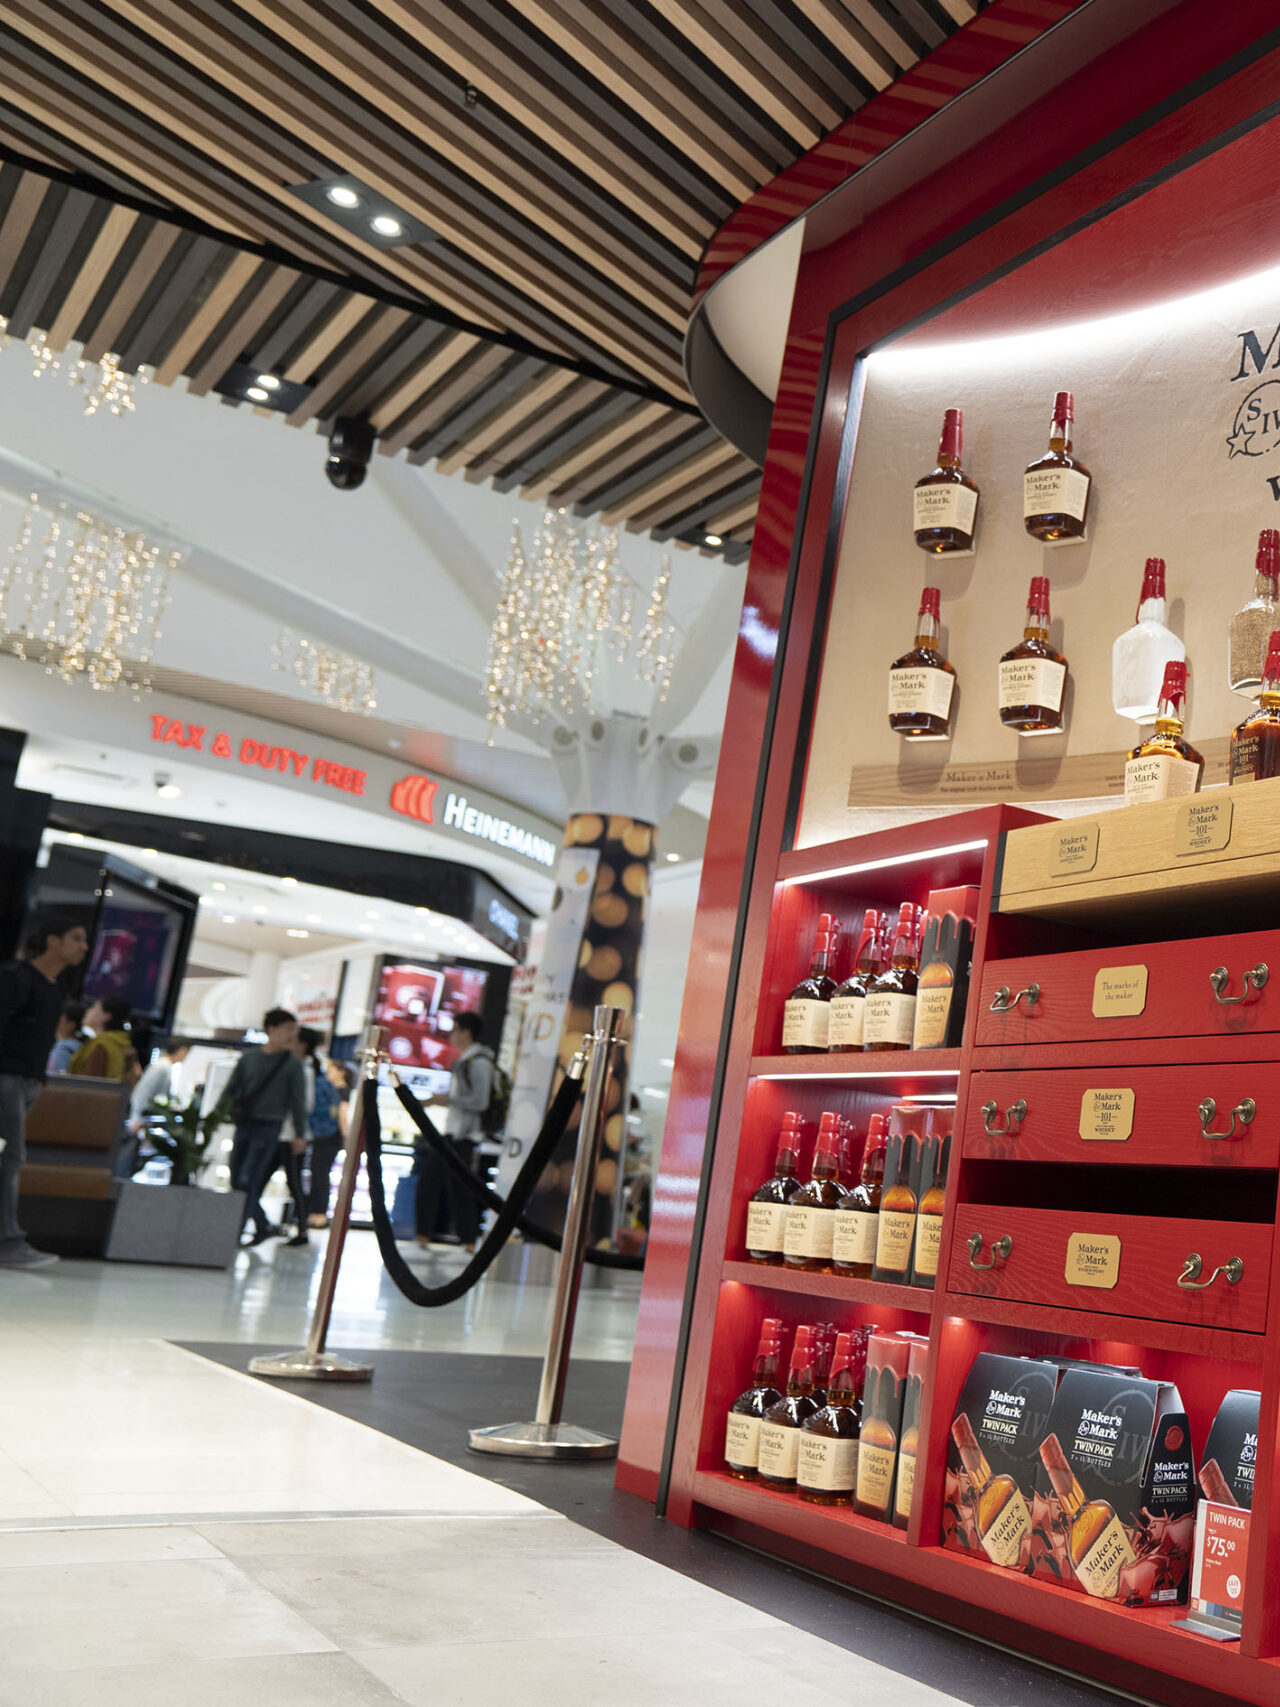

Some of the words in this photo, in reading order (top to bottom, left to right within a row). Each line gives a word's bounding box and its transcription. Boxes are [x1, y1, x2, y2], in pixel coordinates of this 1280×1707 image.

[151, 714, 206, 751] TAX
[211, 733, 231, 759] &
[239, 738, 310, 776] DUTY
[313, 758, 368, 796] FREE
[1127, 762, 1160, 774] Maker's
[1134, 772, 1159, 783] Mark
[1189, 804, 1219, 816] Maker's
[1196, 814, 1218, 824] Mark
[443, 793, 555, 867] HEINEMANN
[1102, 981, 1112, 990] The
[1094, 1093, 1122, 1101] Maker's
[1101, 1102, 1121, 1111] Mark
[1101, 1112, 1111, 1122] 101
[884, 1217, 910, 1228] Maker's
[890, 1228, 908, 1239] Mark
[1078, 1244, 1109, 1254] Maker's
[1085, 1255, 1108, 1266] Mark
[989, 1389, 1026, 1406] Maker's
[996, 1403, 1021, 1418] Mark
[1081, 1408, 1122, 1427] Maker's
[982, 1419, 1000, 1431] TWIN
[1000, 1423, 1019, 1435] PACK
[1089, 1423, 1118, 1440] Mark
[994, 1435, 1015, 1445] BOTTLES
[1074, 1440, 1095, 1453] TWIN
[1094, 1444, 1115, 1457] PACK
[1087, 1457, 1111, 1468] BOTTLES
[1154, 1462, 1189, 1471] Maker's
[869, 1464, 888, 1477] Mark
[1164, 1471, 1188, 1480] Mark
[1152, 1487, 1169, 1495] TWIN
[1170, 1486, 1187, 1494] PACK
[990, 1502, 1020, 1545] Maker's
[1210, 1511, 1227, 1525] TWIN
[1228, 1516, 1246, 1529] PACK
[1002, 1515, 1025, 1547] Mark
[1085, 1530, 1119, 1577] Maker's
[1099, 1543, 1124, 1577] Mark
